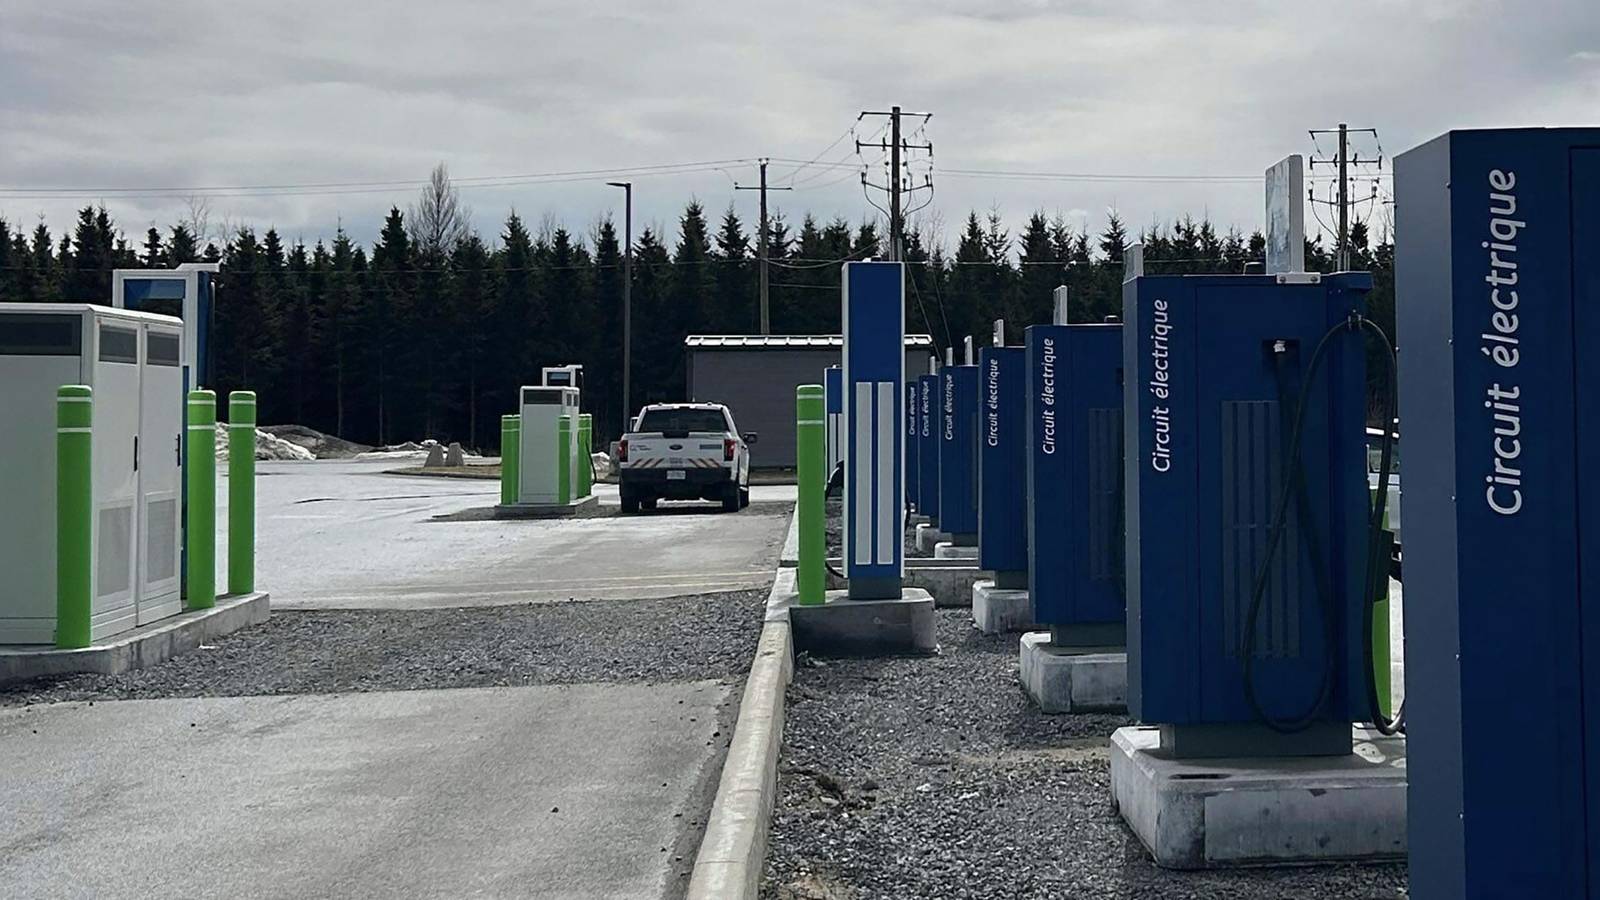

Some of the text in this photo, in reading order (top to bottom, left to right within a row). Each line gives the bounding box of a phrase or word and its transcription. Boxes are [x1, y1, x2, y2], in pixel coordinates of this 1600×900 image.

[1041, 338, 1057, 455] Circuit électrique
[1149, 299, 1173, 472] Circuit électrique
[1481, 169, 1526, 515] Circuit électrique
[945, 415, 953, 441] Circuit
[987, 359, 1000, 447] Circuit électrique
